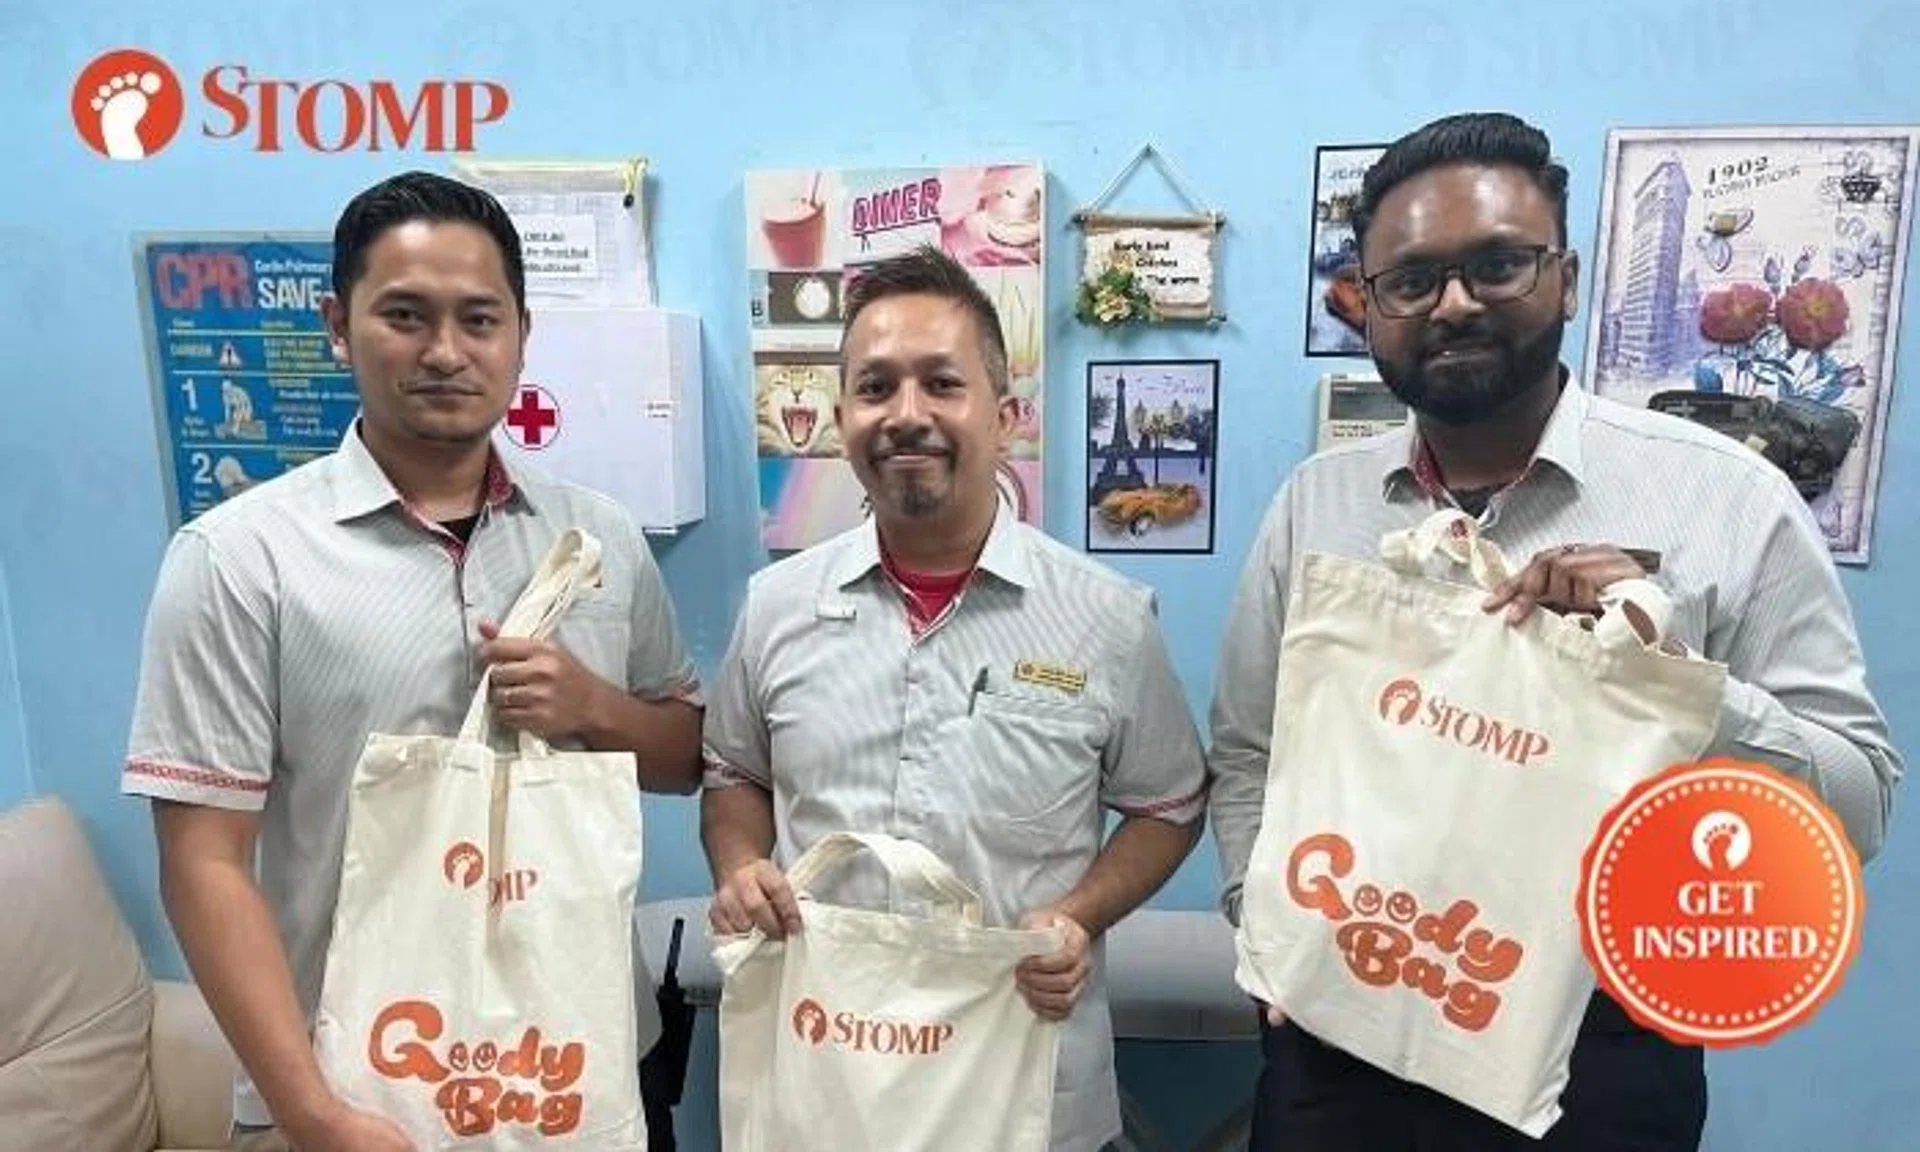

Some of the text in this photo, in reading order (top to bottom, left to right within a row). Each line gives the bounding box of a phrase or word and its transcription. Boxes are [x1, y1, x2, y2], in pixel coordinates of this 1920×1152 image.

[1708, 156, 1768, 185] 1902
[853, 178, 942, 231] DINER
[155, 252, 252, 309] CPR
[181, 378, 198, 411] 1
[192, 452, 213, 485] 2
[1420, 697, 1549, 765] STOMP
[1287, 833, 1524, 983] Goody
[1336, 921, 1502, 1033] Bag
[368, 1000, 585, 1093] Goody
[833, 1012, 954, 1055] STOMP
[435, 1077, 583, 1138] Bag
